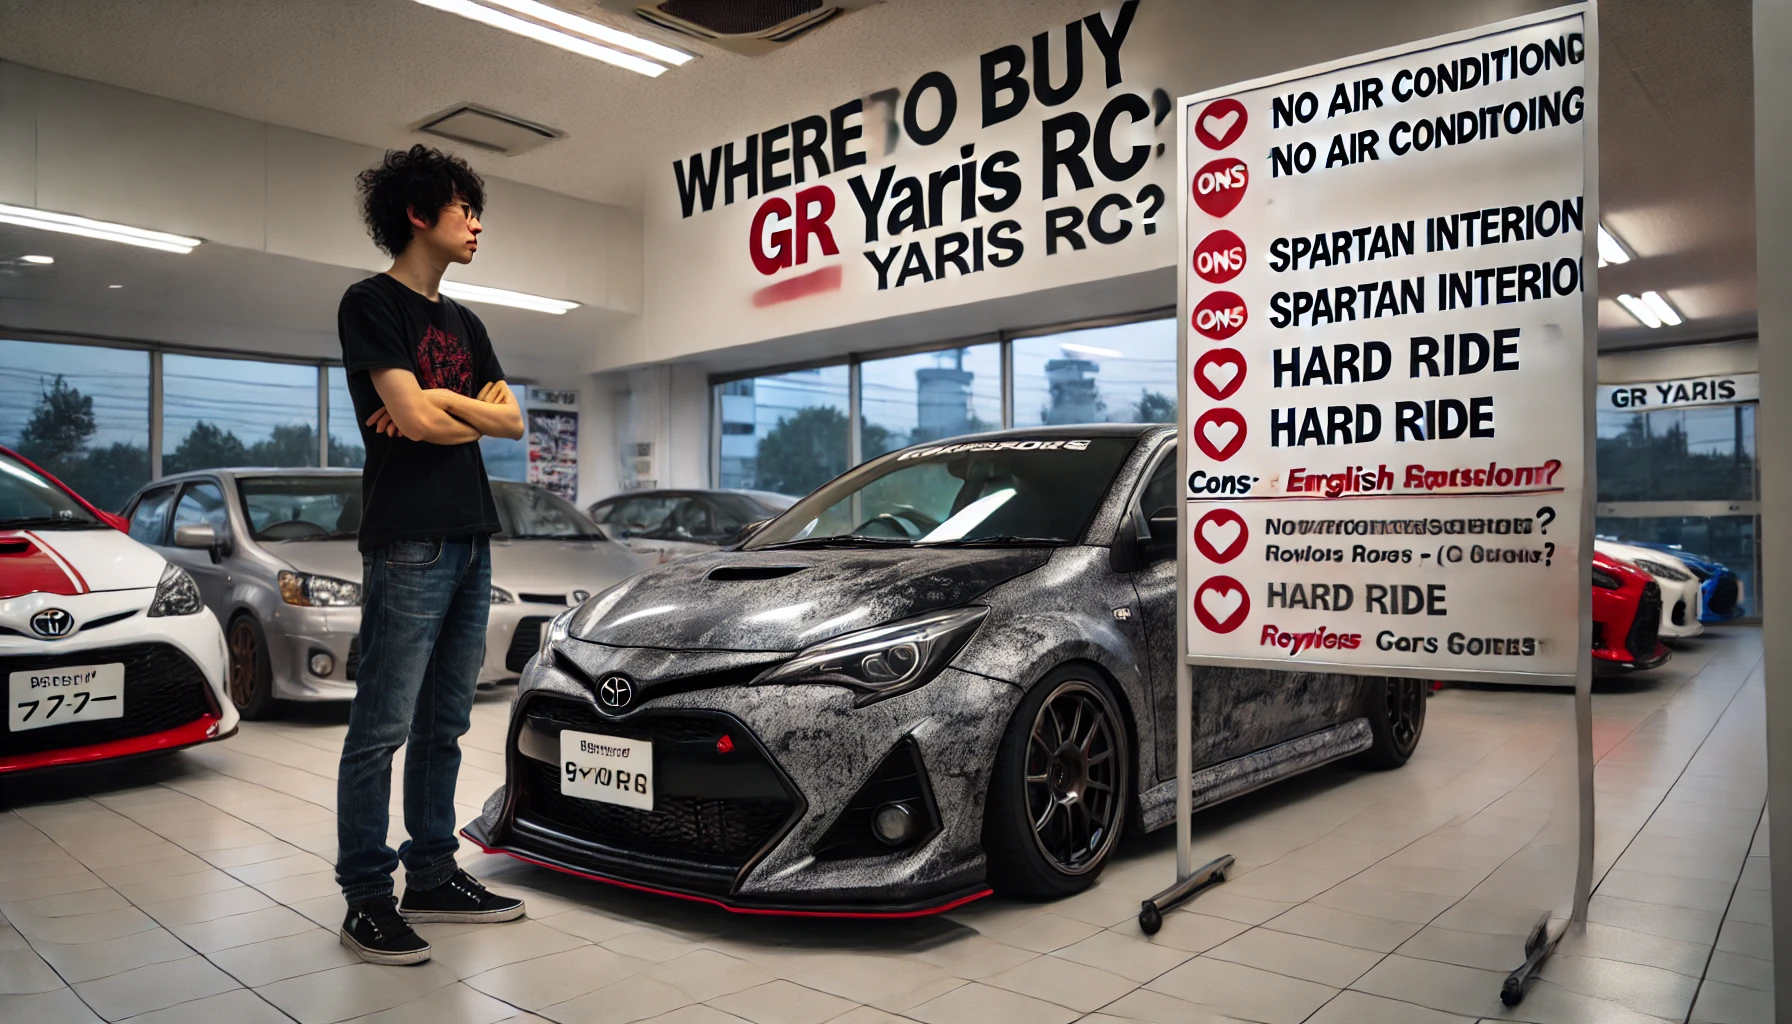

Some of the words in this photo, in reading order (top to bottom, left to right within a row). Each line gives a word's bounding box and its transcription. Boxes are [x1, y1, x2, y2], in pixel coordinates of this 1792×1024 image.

[672, 98, 866, 219] WHERE
[980, 0, 1140, 129] BUY
[1272, 91, 1318, 129] NO
[1328, 77, 1383, 118] AIR
[1270, 141, 1316, 178] NO
[1325, 129, 1379, 169] AIR
[1389, 86, 1584, 156] CONDITOING
[1197, 164, 1246, 195] ONS
[749, 185, 839, 275] GR
[847, 143, 1021, 242] Yaris
[863, 219, 1023, 290] YARIS
[1046, 183, 1165, 256] RC?
[1197, 246, 1243, 274] ONS
[1269, 220, 1414, 273] SPARTAN
[1269, 276, 1425, 329] SPARTAN
[1273, 340, 1392, 388] HARD
[1409, 327, 1521, 379] RIDE
[1611, 388, 1647, 407] GR
[1656, 380, 1736, 403] YARIS
[1270, 403, 1381, 447] HARD
[1394, 396, 1495, 443] RIDE
[1267, 582, 1354, 611] HARD
[1365, 584, 1447, 616] RIDE
